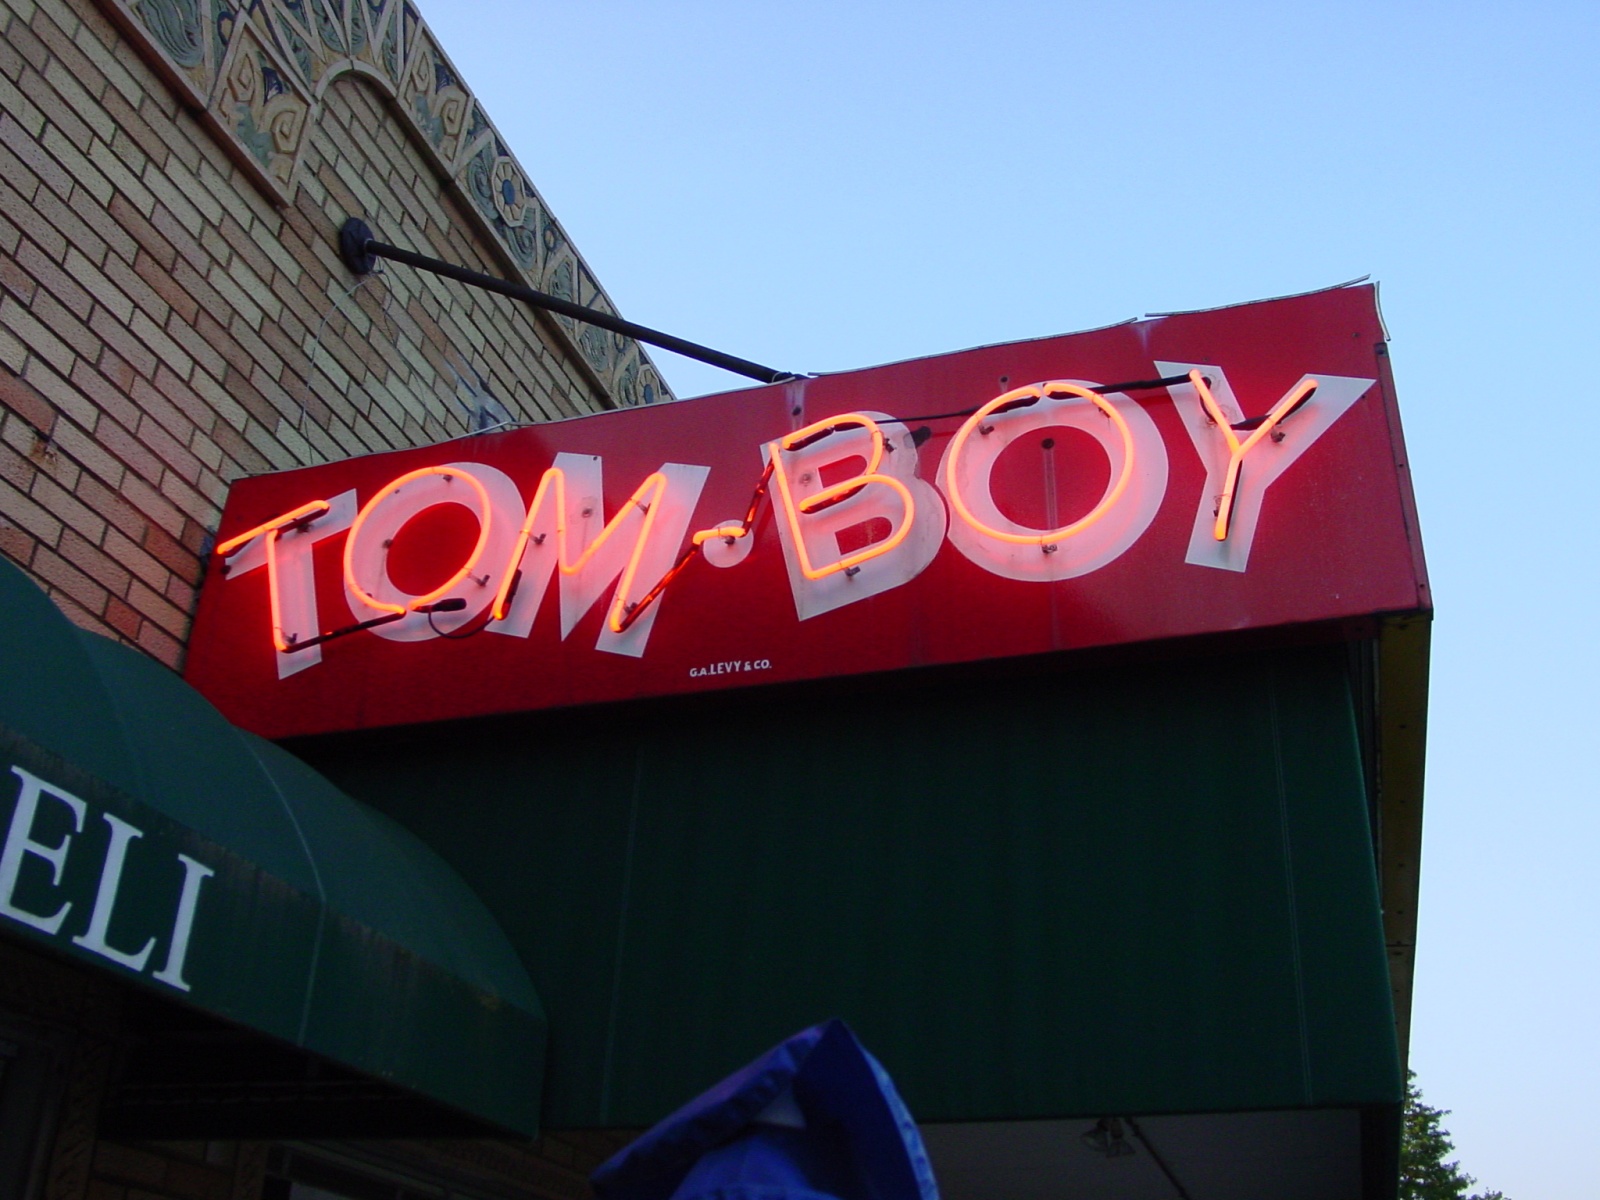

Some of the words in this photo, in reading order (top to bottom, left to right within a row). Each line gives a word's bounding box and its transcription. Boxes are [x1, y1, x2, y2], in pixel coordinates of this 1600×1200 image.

[743, 661, 752, 671] &
[753, 659, 772, 669] CO.
[0, 764, 215, 993] ELI
